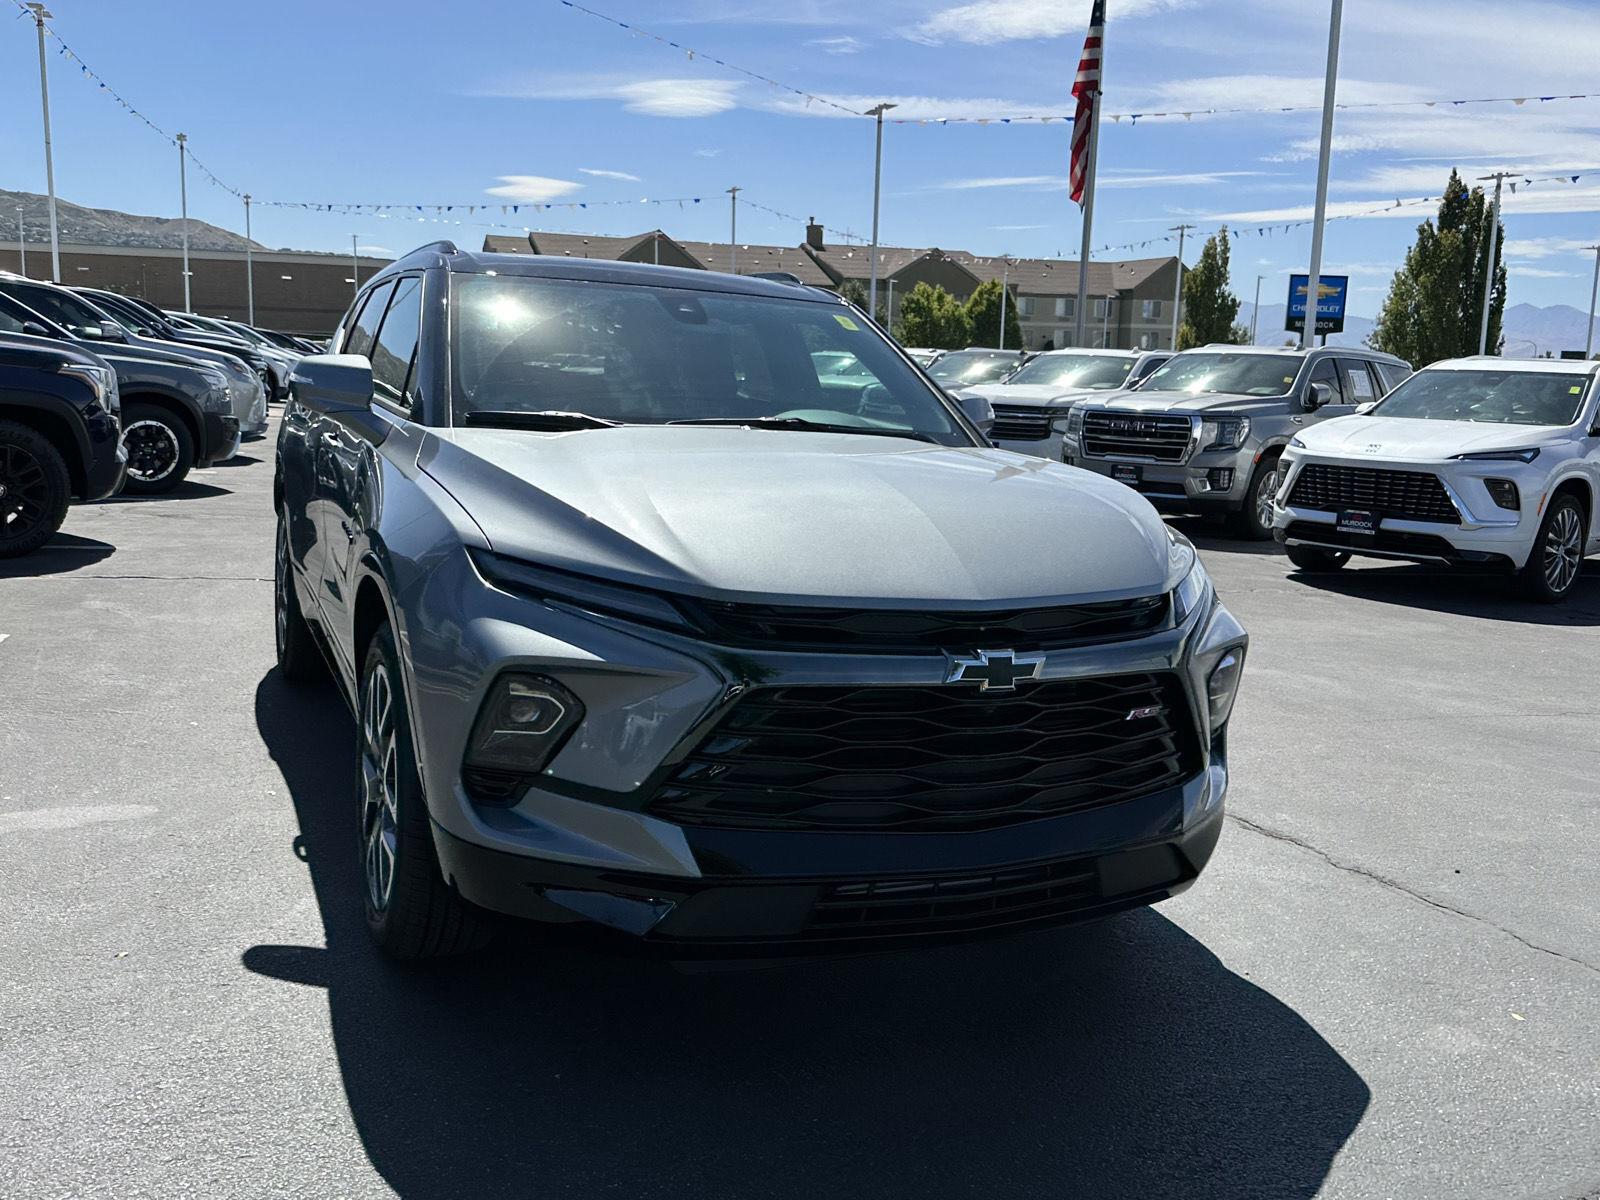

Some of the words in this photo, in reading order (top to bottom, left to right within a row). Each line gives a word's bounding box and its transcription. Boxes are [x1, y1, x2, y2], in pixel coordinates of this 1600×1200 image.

[1110, 420, 1156, 432] GMC
[1341, 519, 1373, 529] MURDOCK
[1125, 706, 1161, 720] RS
